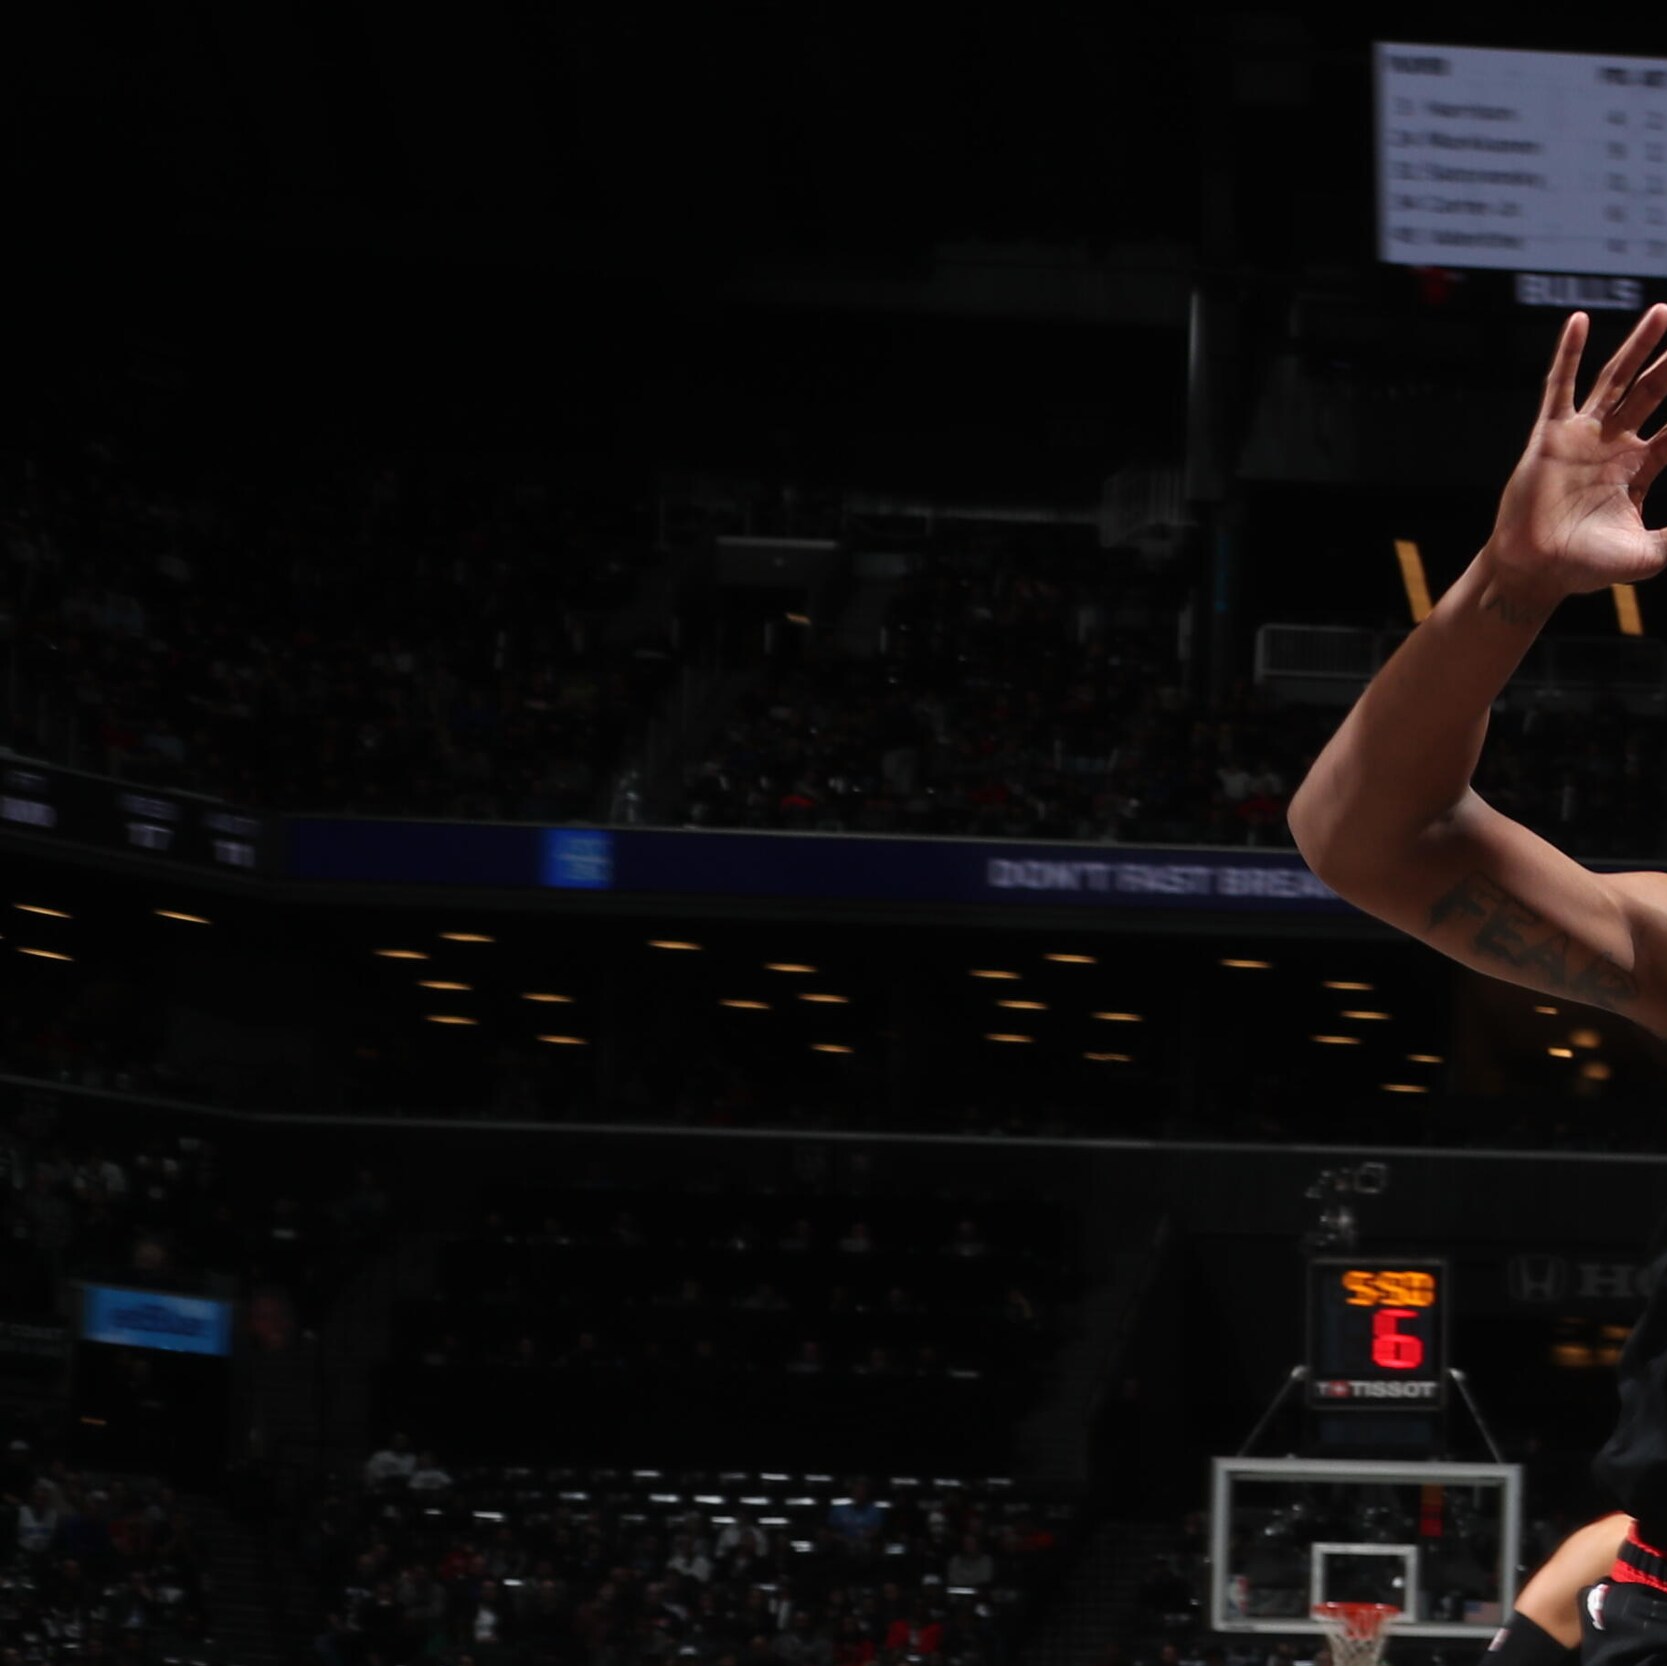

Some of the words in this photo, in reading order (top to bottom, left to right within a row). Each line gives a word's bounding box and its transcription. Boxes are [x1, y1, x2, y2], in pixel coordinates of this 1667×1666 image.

[1514, 273, 1645, 311] BULLS
[1114, 862, 1212, 895] FAST
[1216, 866, 1341, 899] BREA
[1371, 1307, 1424, 1368] 6
[1348, 1381, 1438, 1398] TISSOT
